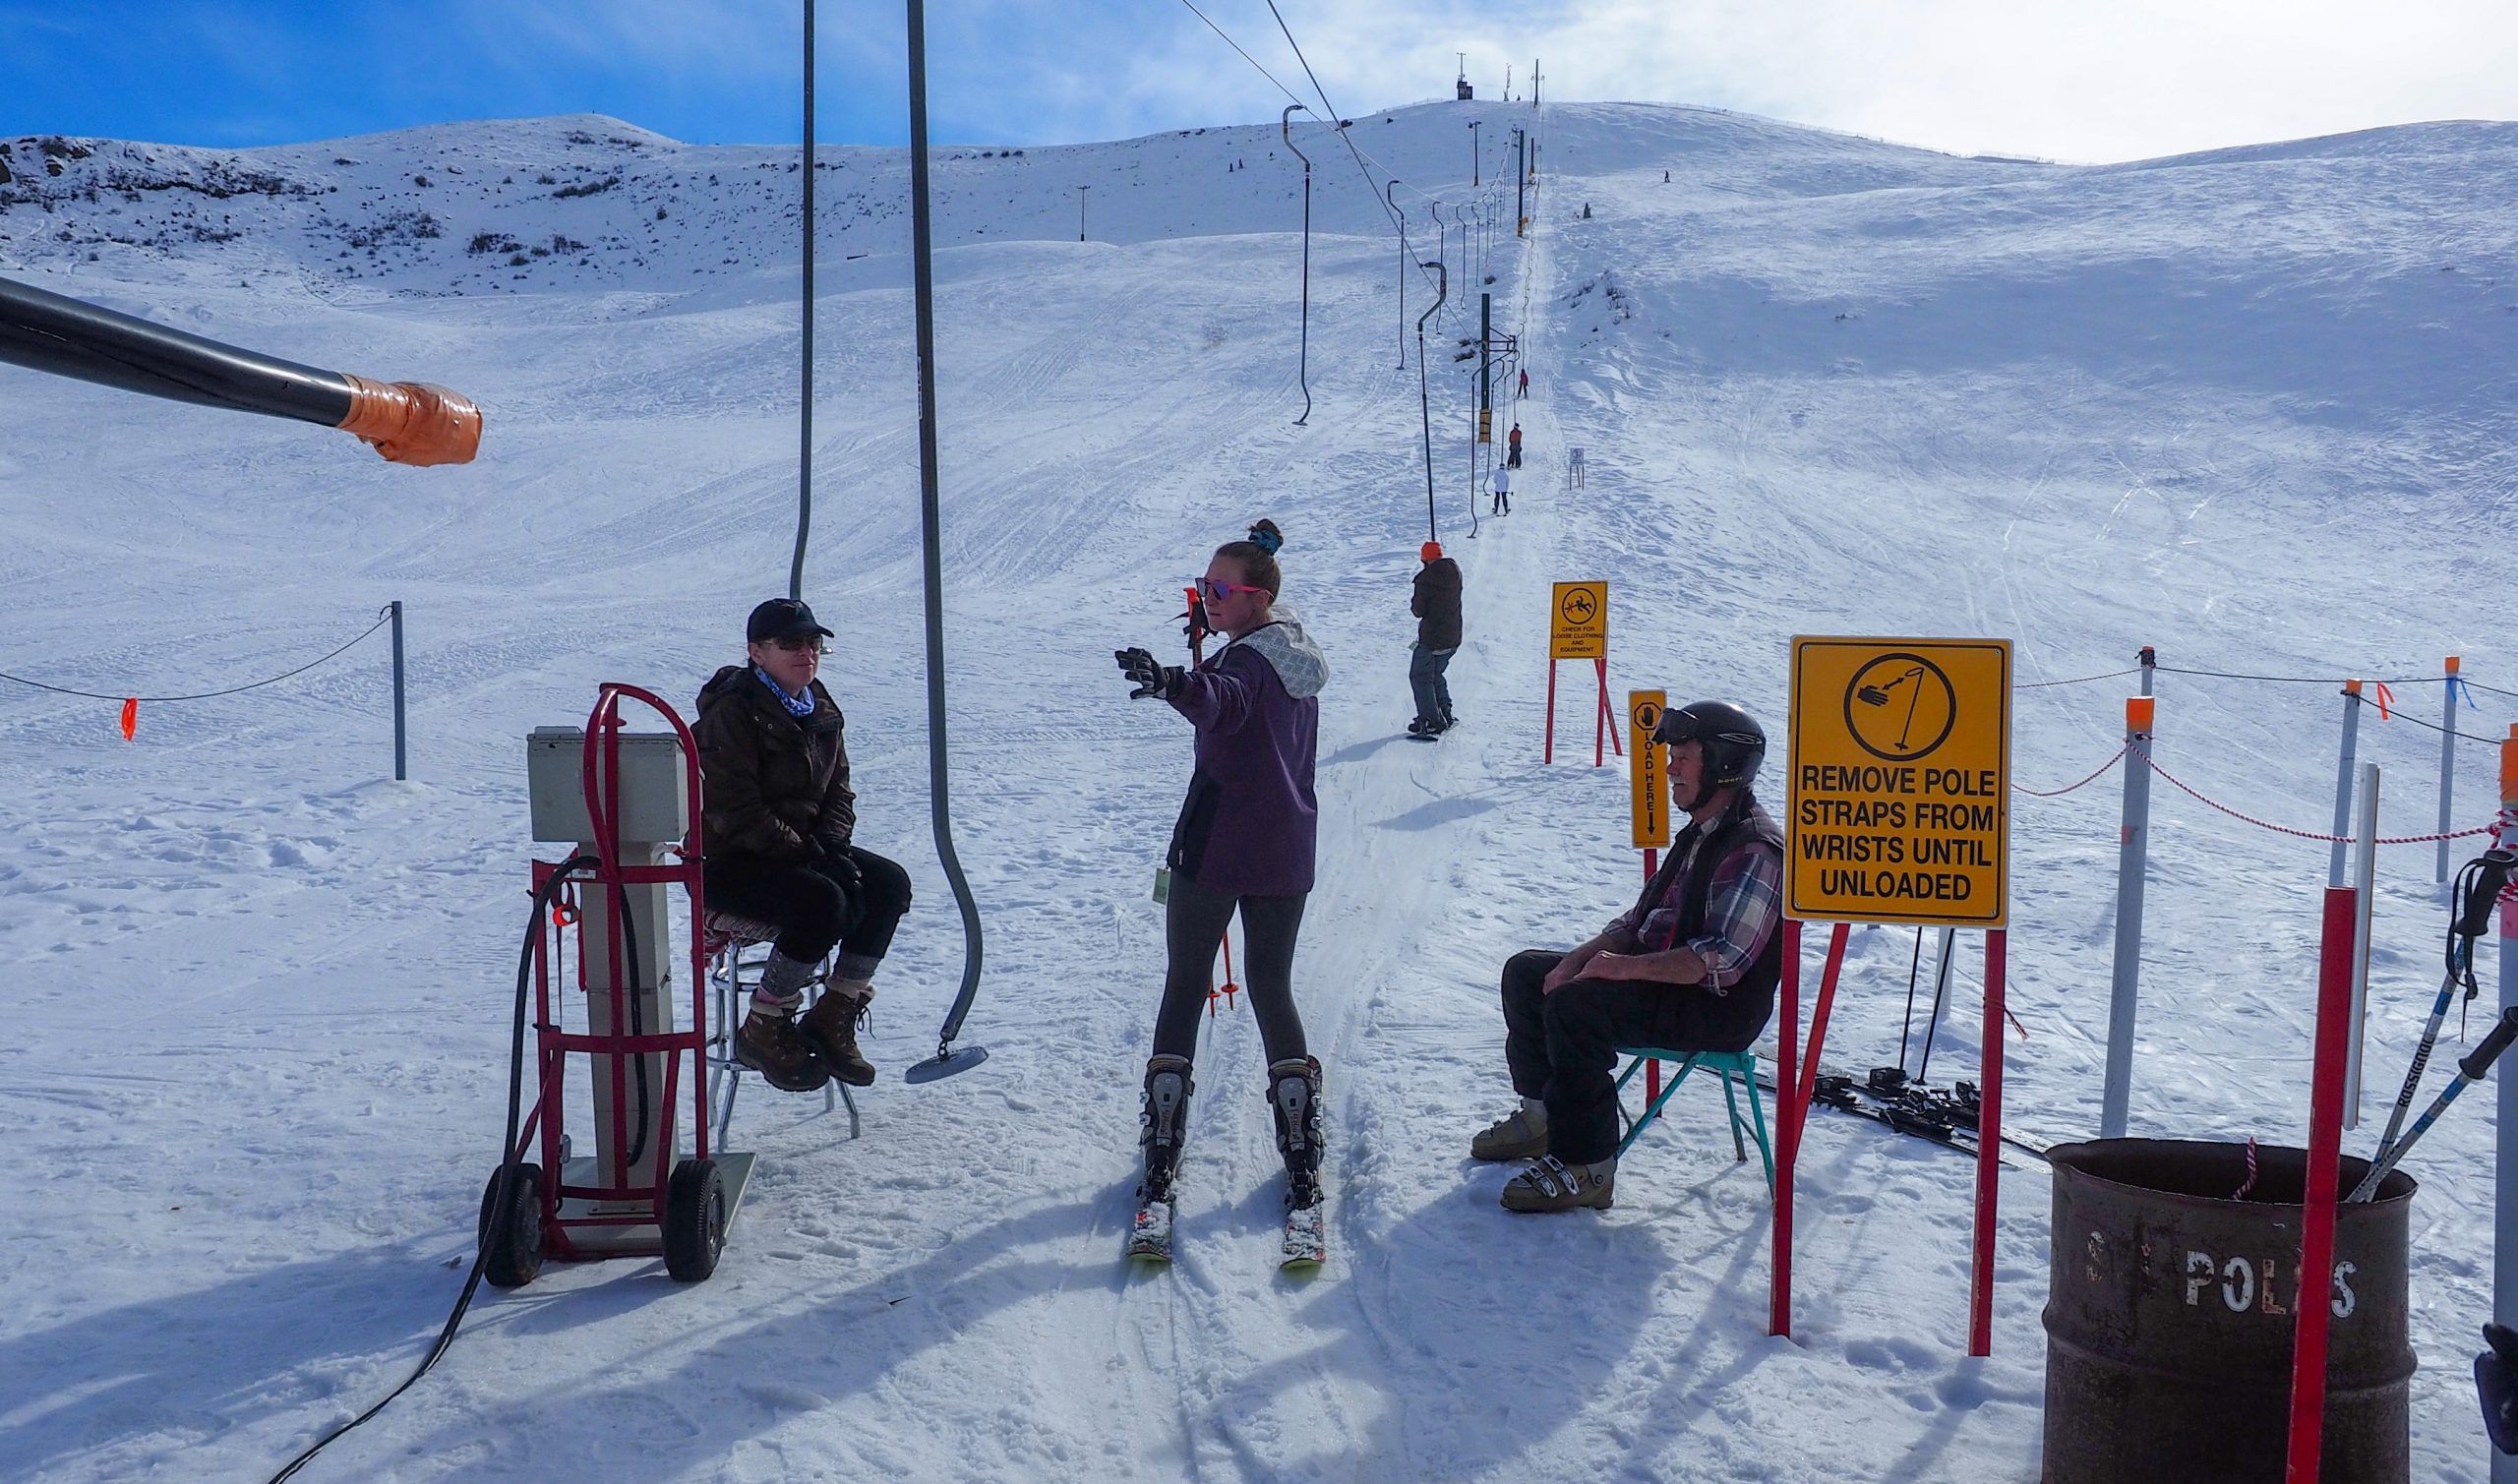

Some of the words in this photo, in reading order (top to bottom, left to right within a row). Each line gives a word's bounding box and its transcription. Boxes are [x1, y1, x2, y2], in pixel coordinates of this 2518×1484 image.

[1645, 732, 1653, 769] LOAD
[1646, 774, 1654, 811] HERE
[1802, 765, 1916, 794] REMOVE
[1925, 769, 1995, 796] POLE
[1800, 799, 1906, 828] STRAPS
[1915, 802, 1994, 831] FROM
[1802, 834, 1904, 862] WRISTS
[1913, 838, 1992, 866] UNTIL
[1821, 869, 1971, 901] UNLOADED
[2397, 1037, 2435, 1108] ROSSIGNOL
[2186, 1250, 2358, 1319] POLS
